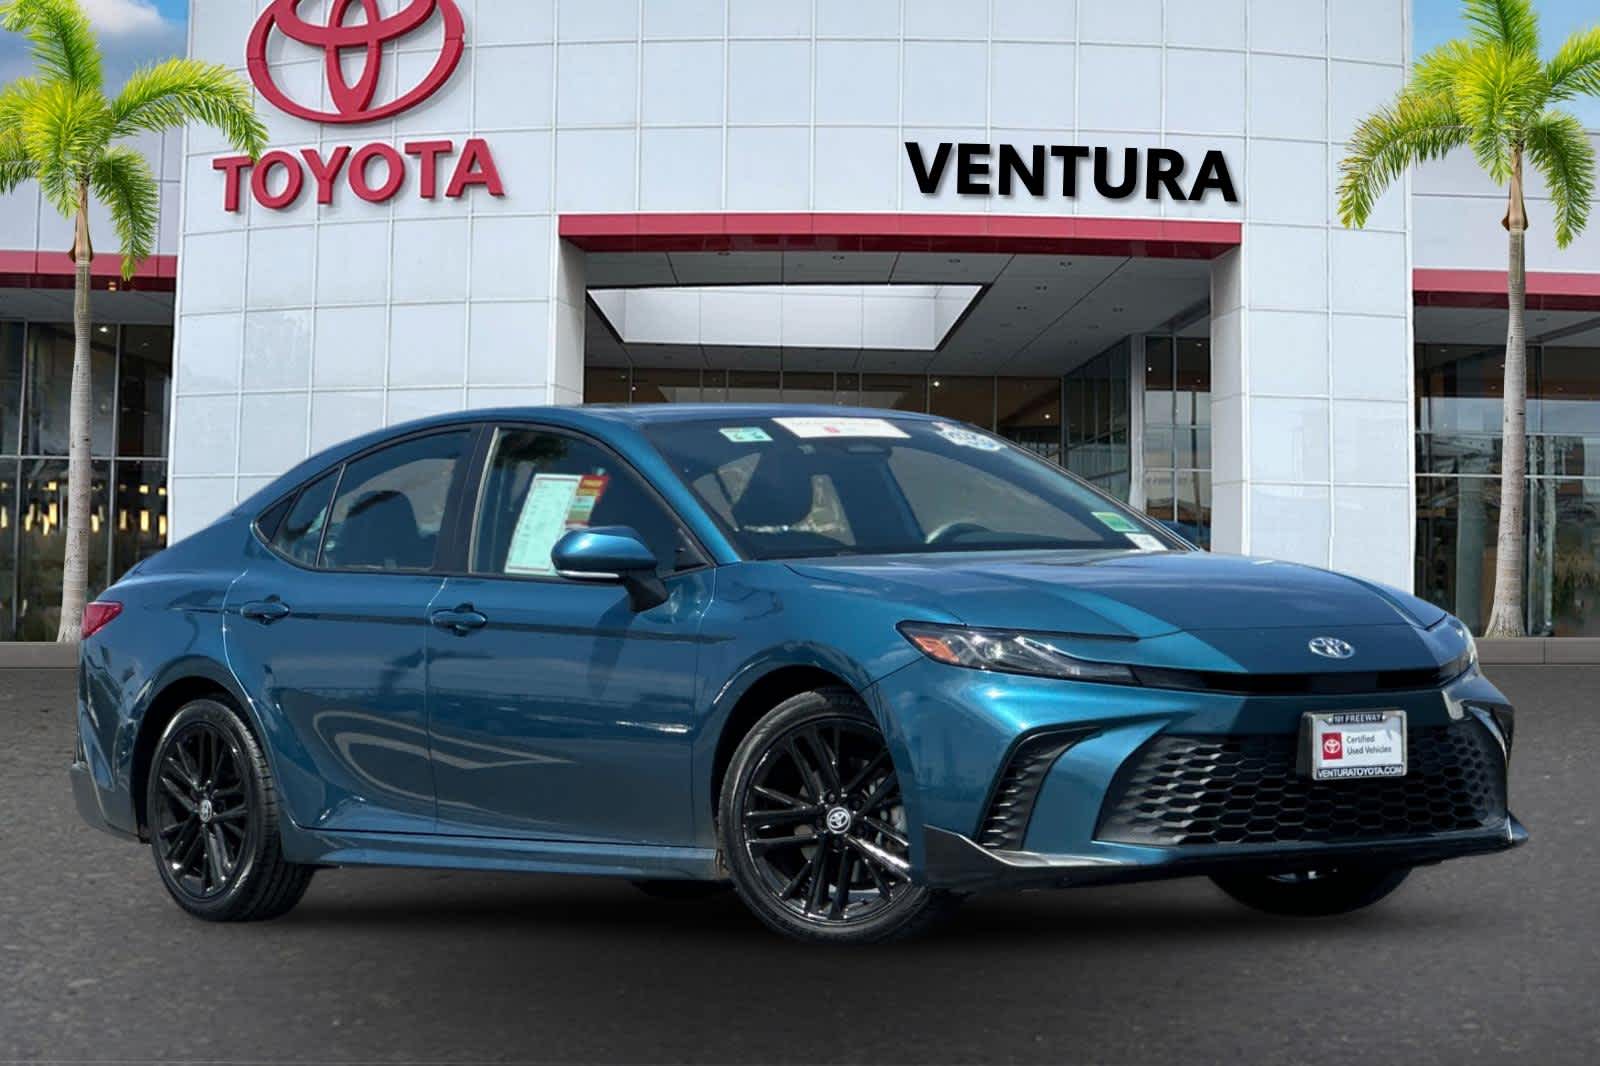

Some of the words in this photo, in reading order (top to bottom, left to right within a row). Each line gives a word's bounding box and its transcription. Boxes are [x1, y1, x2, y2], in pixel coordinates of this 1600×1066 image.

[213, 139, 505, 212] TOYOTA
[904, 142, 1239, 203] VENTURA
[1345, 713, 1381, 723] FREEWAY
[1346, 735, 1376, 744] Certified
[1346, 747, 1364, 755] Used
[1365, 745, 1392, 754] Vehicles
[1317, 766, 1403, 778] VENTURATOYOTA.COM
